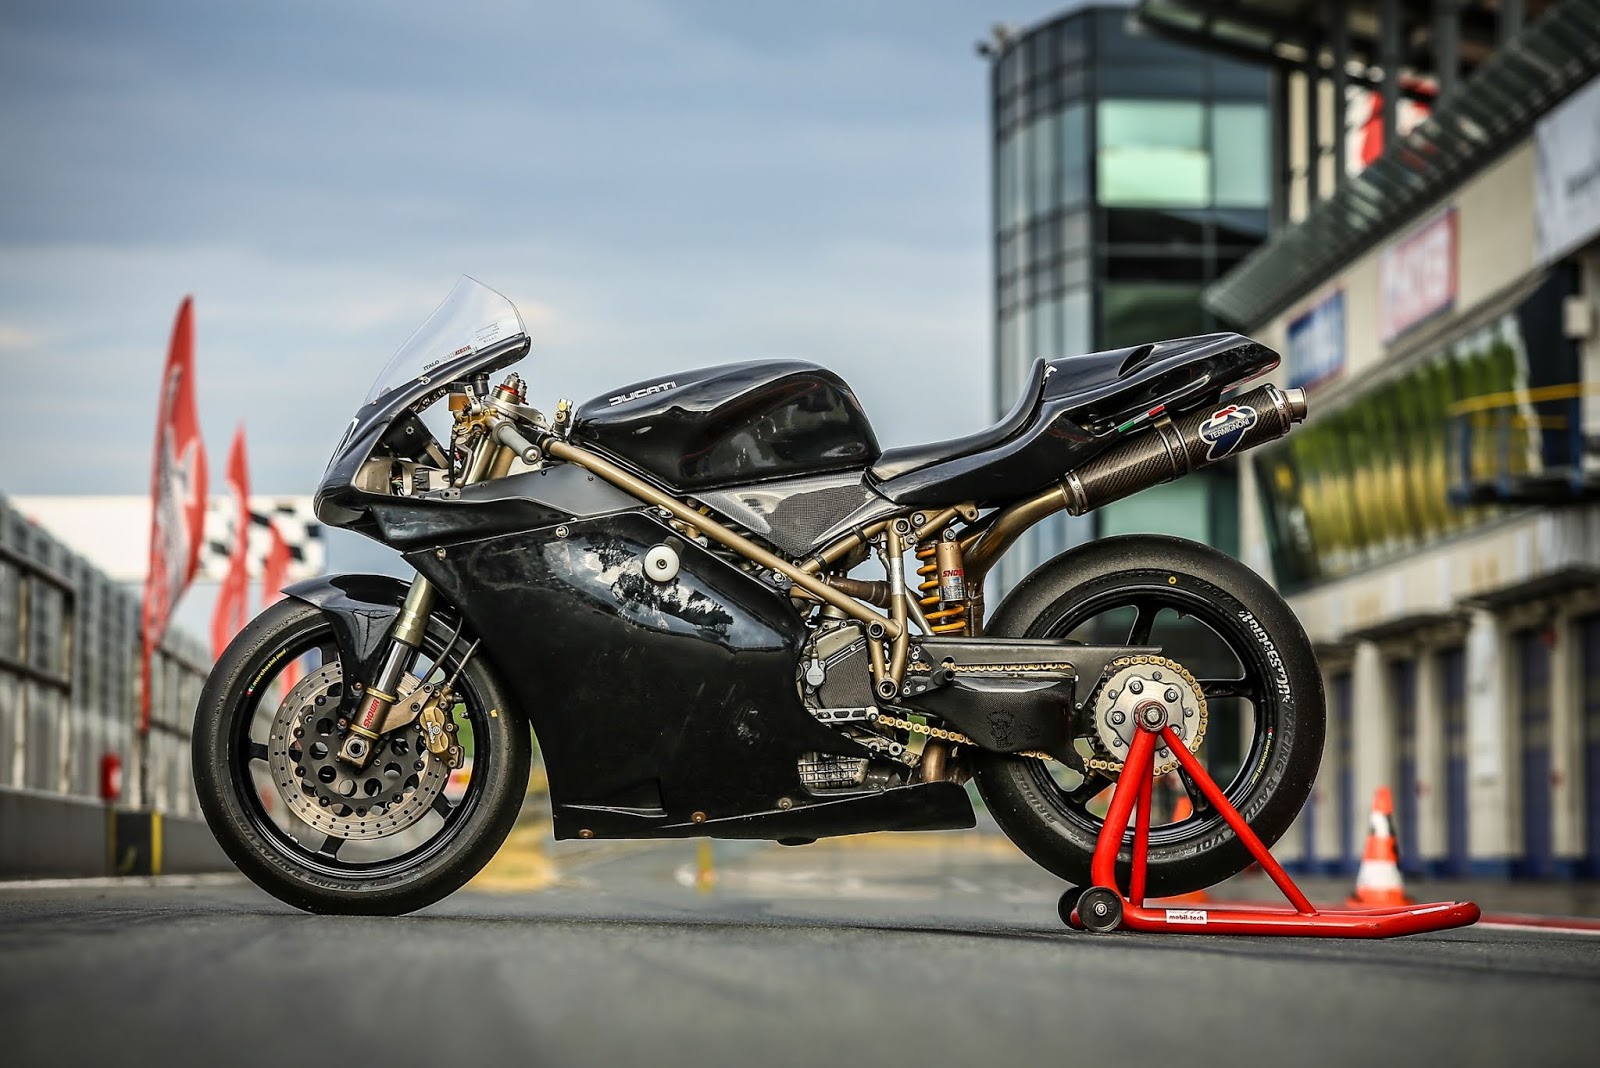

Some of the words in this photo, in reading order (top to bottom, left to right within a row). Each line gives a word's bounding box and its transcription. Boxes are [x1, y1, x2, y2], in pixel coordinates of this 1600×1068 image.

[609, 381, 677, 406] DUCATI
[1209, 418, 1250, 439] TERMIGNONI
[363, 699, 380, 729] SHOWA
[307, 875, 360, 890] RACING
